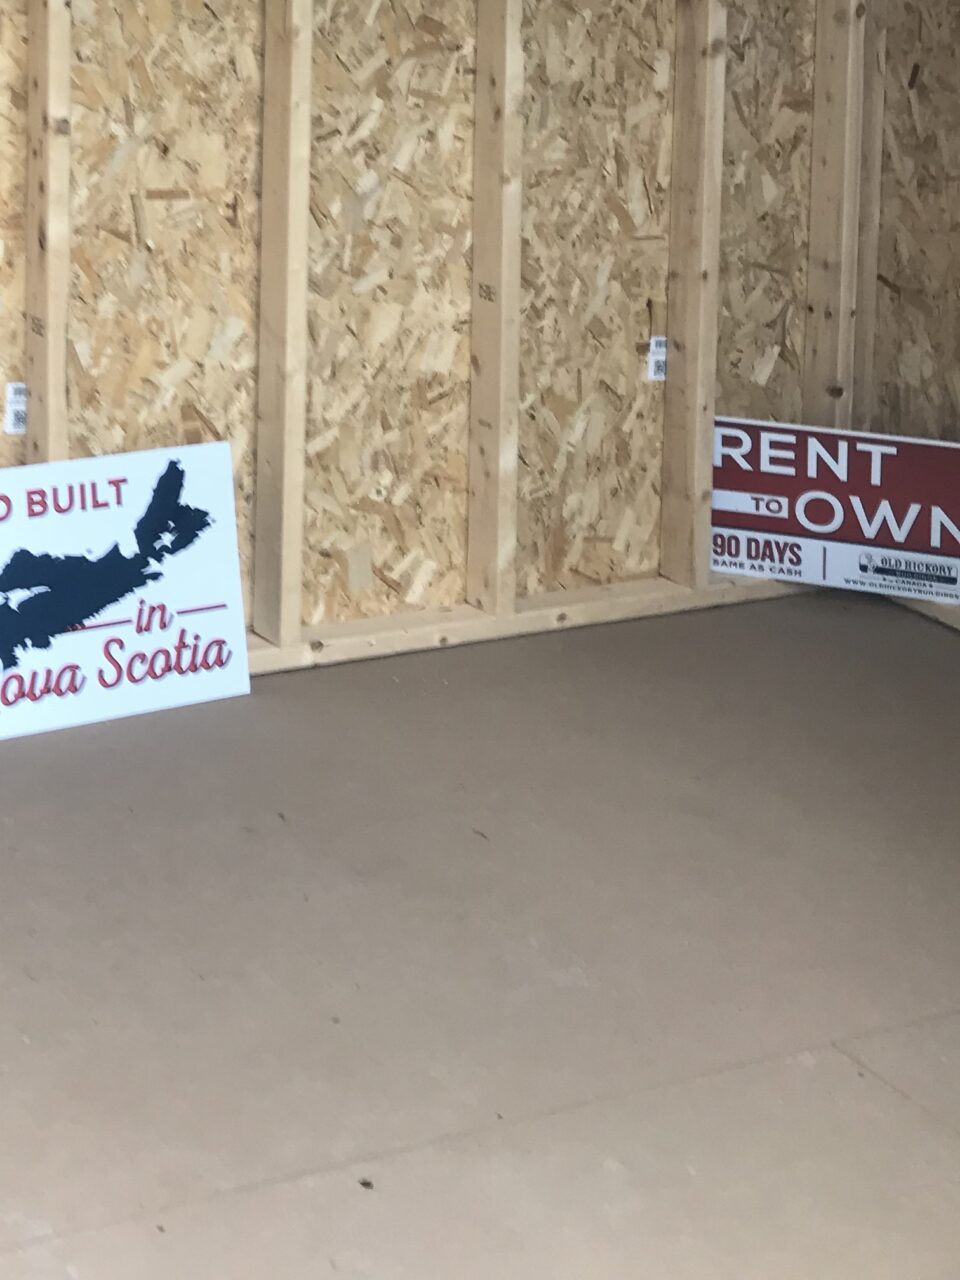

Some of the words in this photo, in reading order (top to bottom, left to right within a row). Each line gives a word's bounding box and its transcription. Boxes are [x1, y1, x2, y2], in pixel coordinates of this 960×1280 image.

[713, 425, 897, 487] RENT
[26, 477, 129, 519] BUILT
[750, 496, 783, 514] TO
[794, 489, 960, 549] OWN
[712, 533, 741, 559] 90
[746, 537, 802, 567] DAYS
[712, 558, 746, 570] SAME
[749, 563, 765, 573] AS
[769, 565, 802, 578] CASH
[880, 556, 902, 569] OLD
[904, 561, 953, 577] HICKORY
[133, 599, 171, 635] in
[96, 627, 232, 691] Scotia
